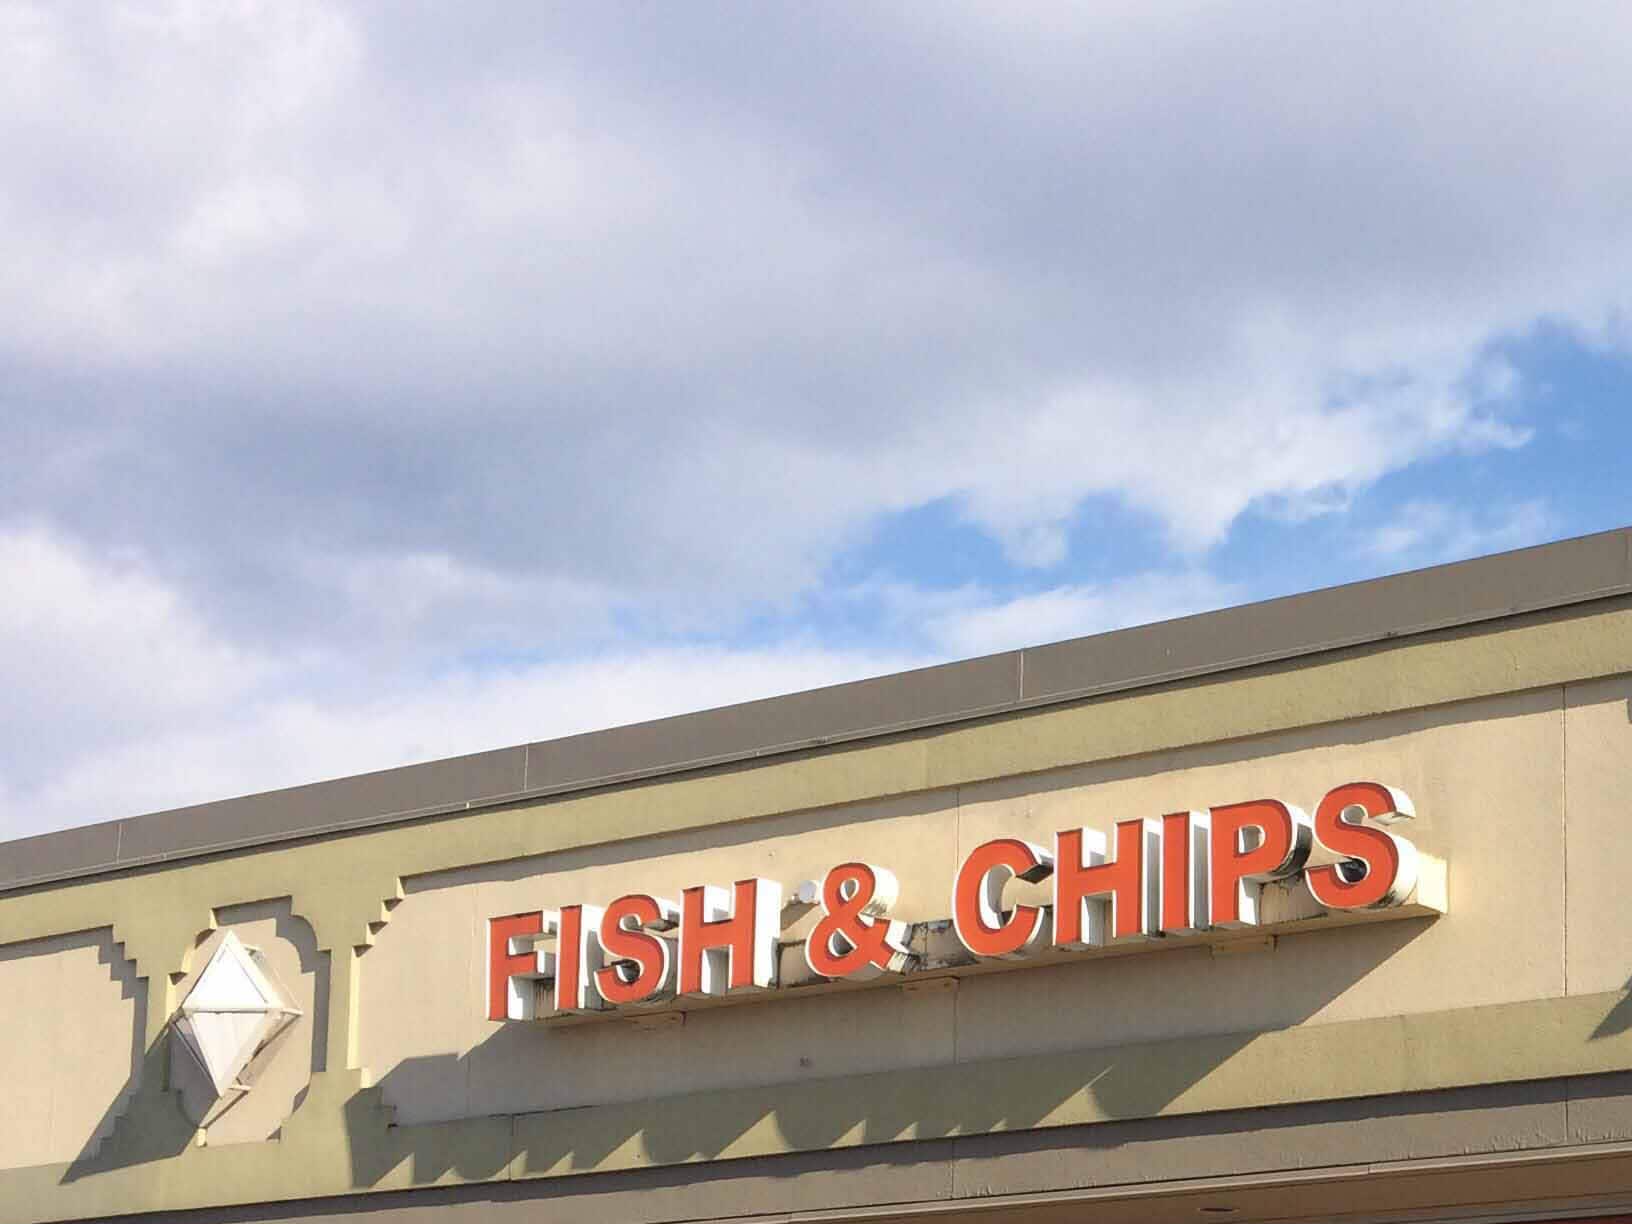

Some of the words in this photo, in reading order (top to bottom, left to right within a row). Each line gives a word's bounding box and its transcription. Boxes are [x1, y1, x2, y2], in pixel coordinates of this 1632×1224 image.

[486, 877, 775, 1022] FISH
[805, 861, 905, 979] &
[952, 781, 1415, 958] CHIPS
